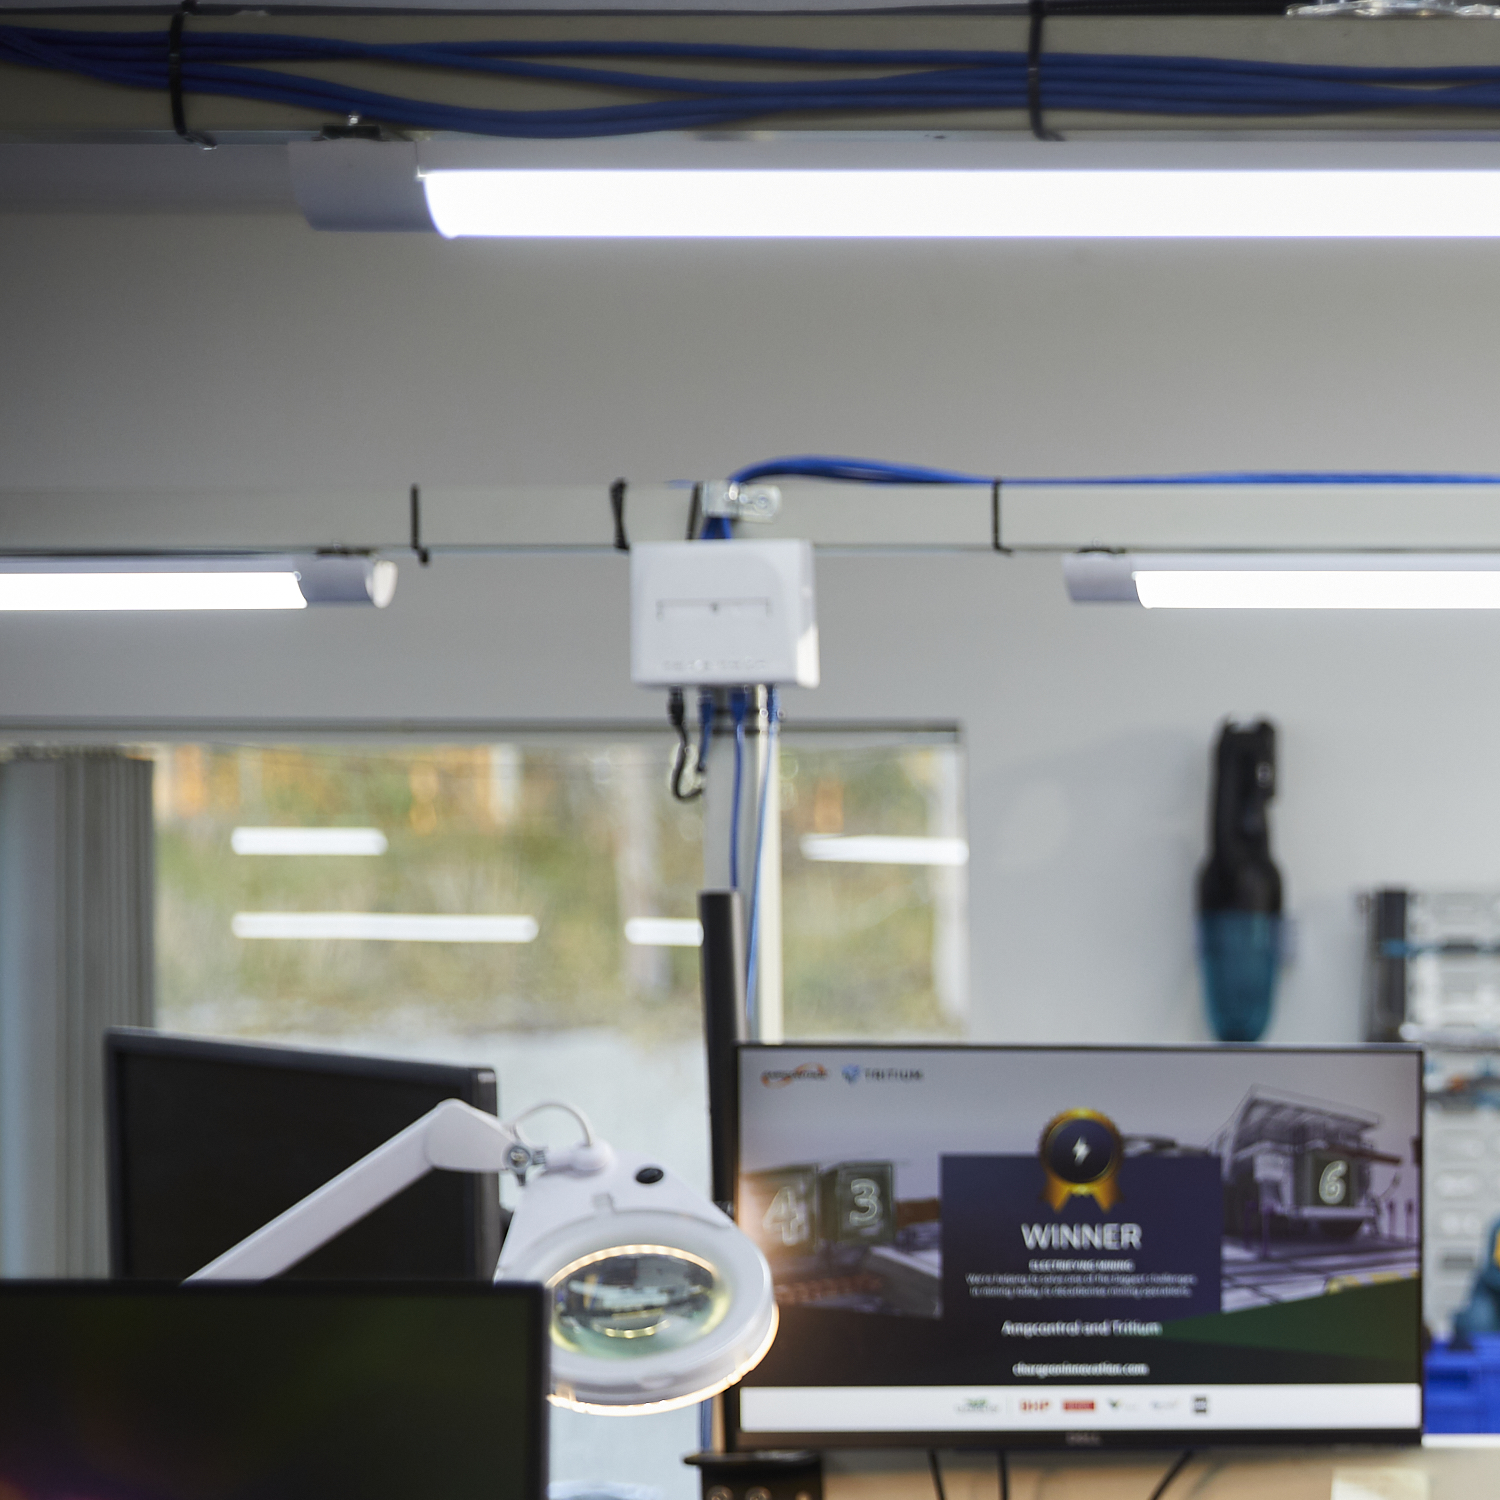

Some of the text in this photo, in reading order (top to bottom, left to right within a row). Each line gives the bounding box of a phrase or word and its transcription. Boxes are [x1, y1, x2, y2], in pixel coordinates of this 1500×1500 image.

[1021, 1223, 1142, 1250] WINNER
[1001, 1319, 1163, 1339] Ampcontrol and Tritium
